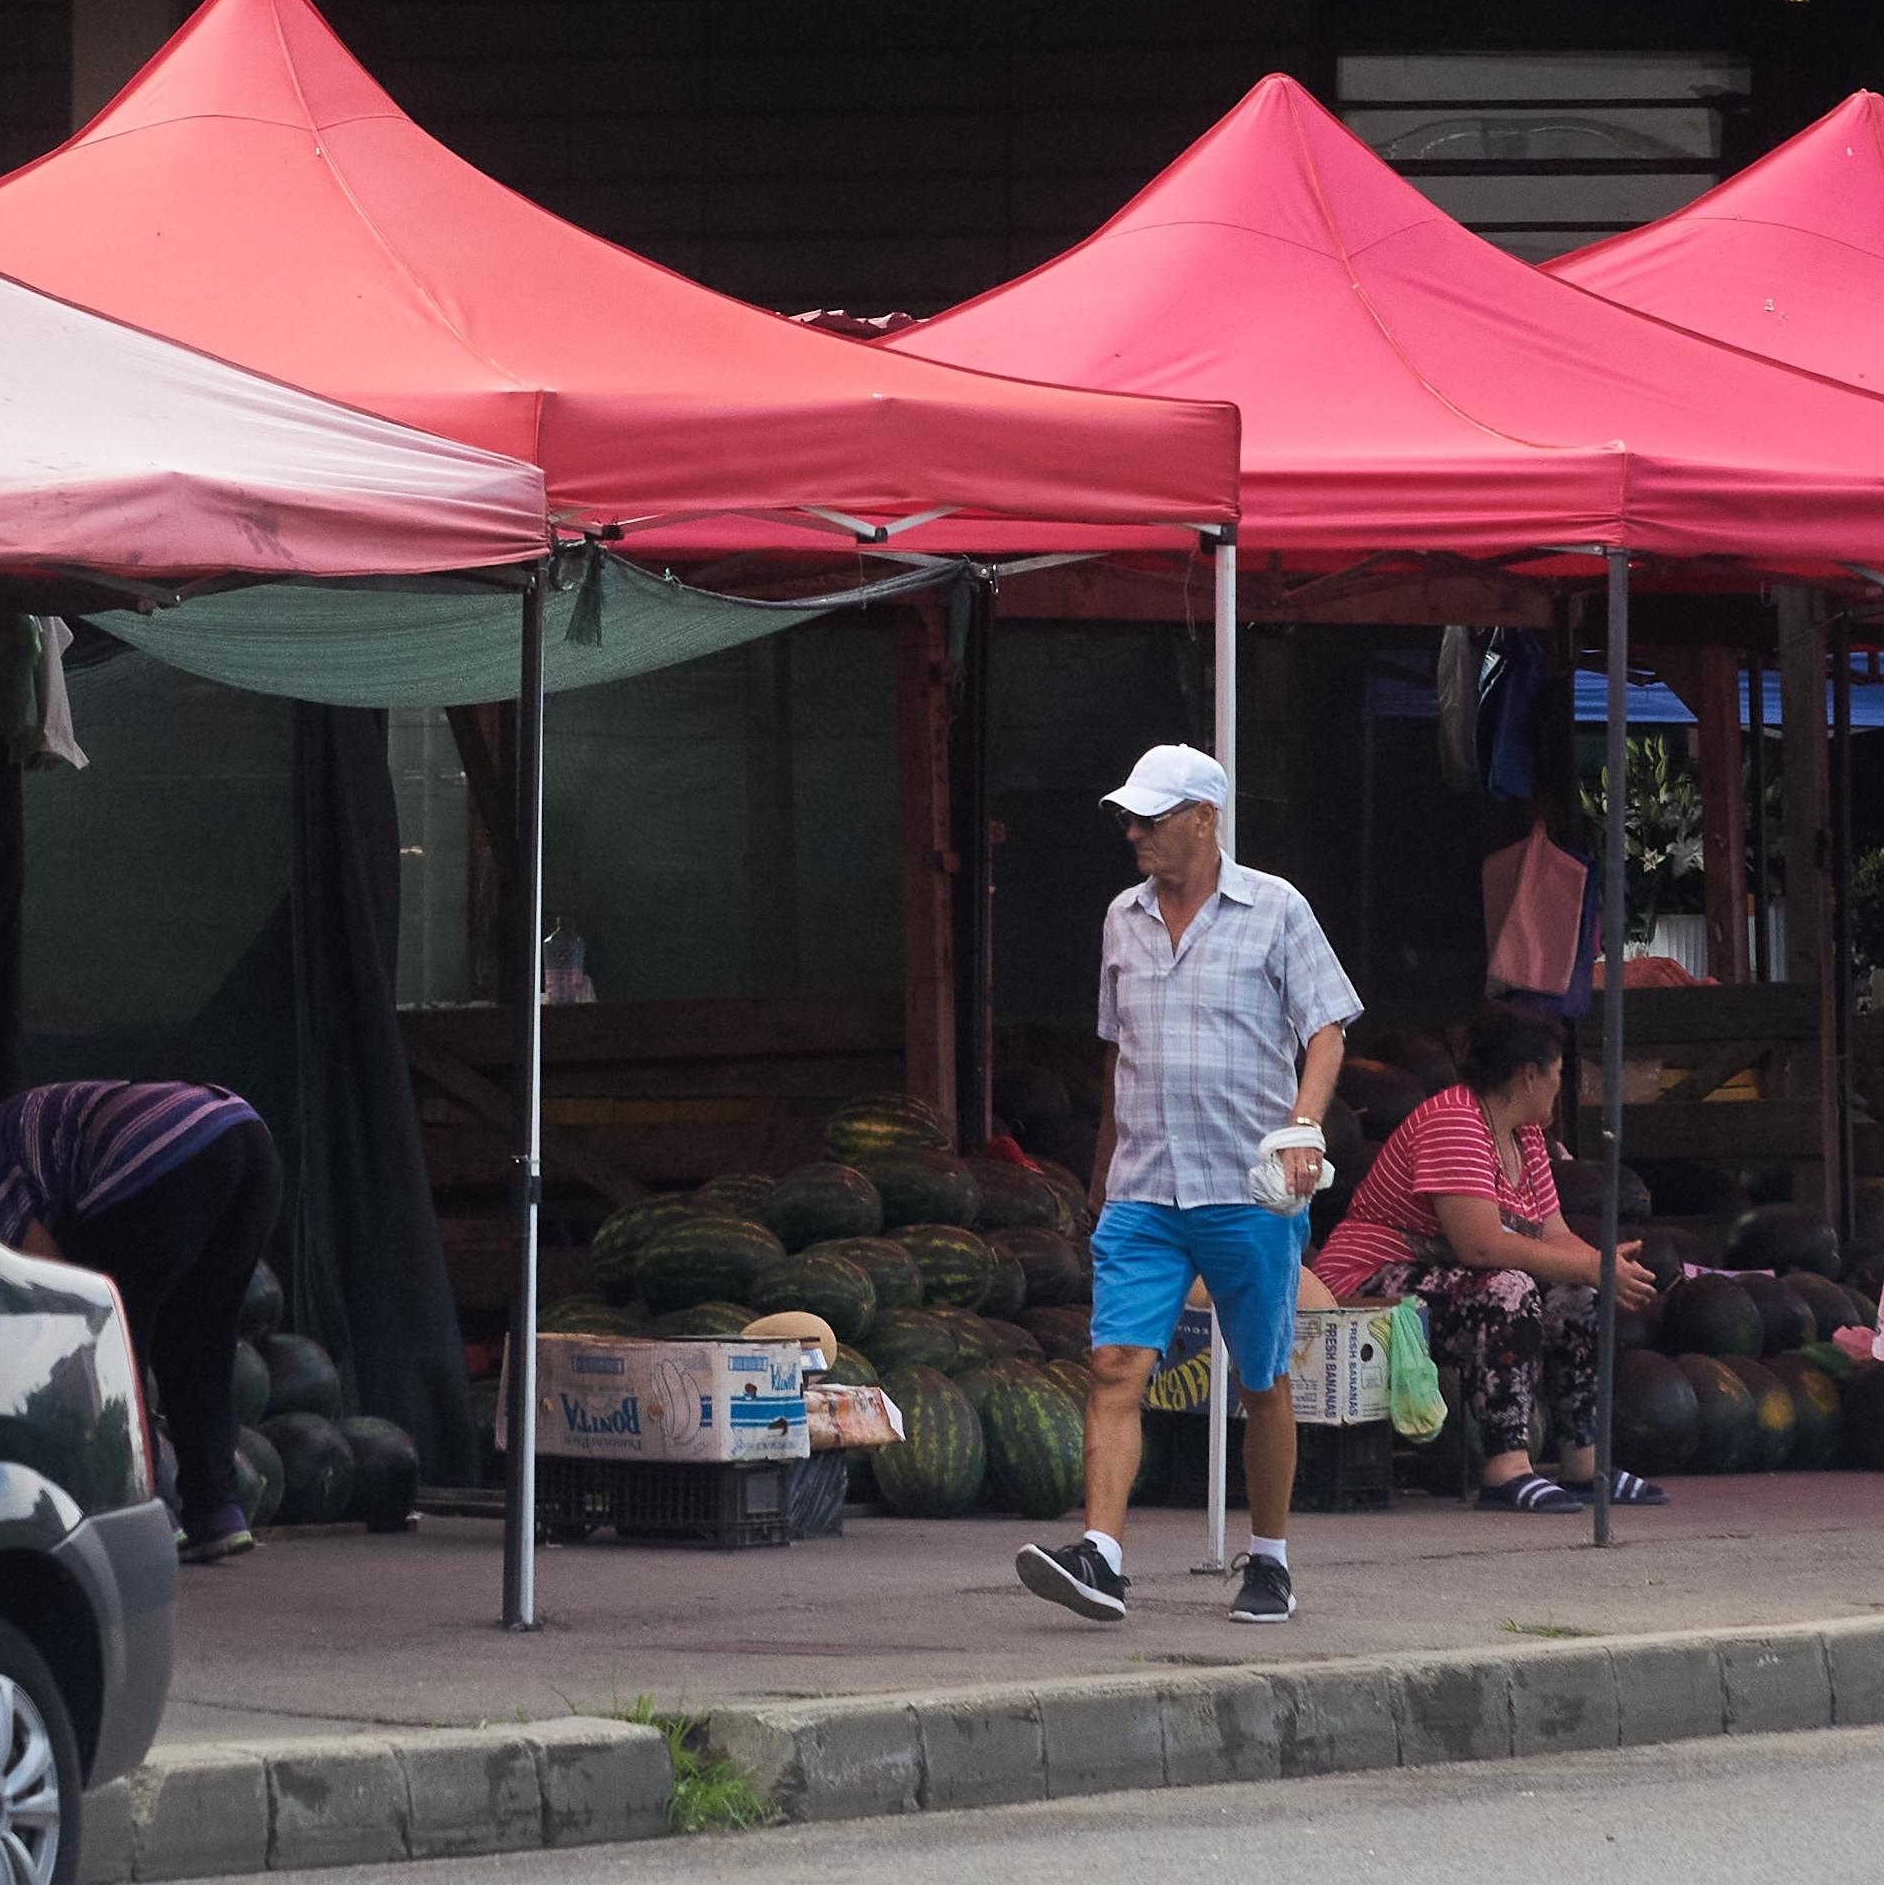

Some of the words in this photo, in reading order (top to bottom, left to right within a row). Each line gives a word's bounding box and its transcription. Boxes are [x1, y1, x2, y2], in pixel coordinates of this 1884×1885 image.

[1324, 1323, 1337, 1361] FRESH
[1348, 1321, 1358, 1358] FRESH
[1323, 1364, 1338, 1419] BANANAS
[1348, 1362, 1359, 1417] BANANAS
[561, 1393, 641, 1435] BONITA
